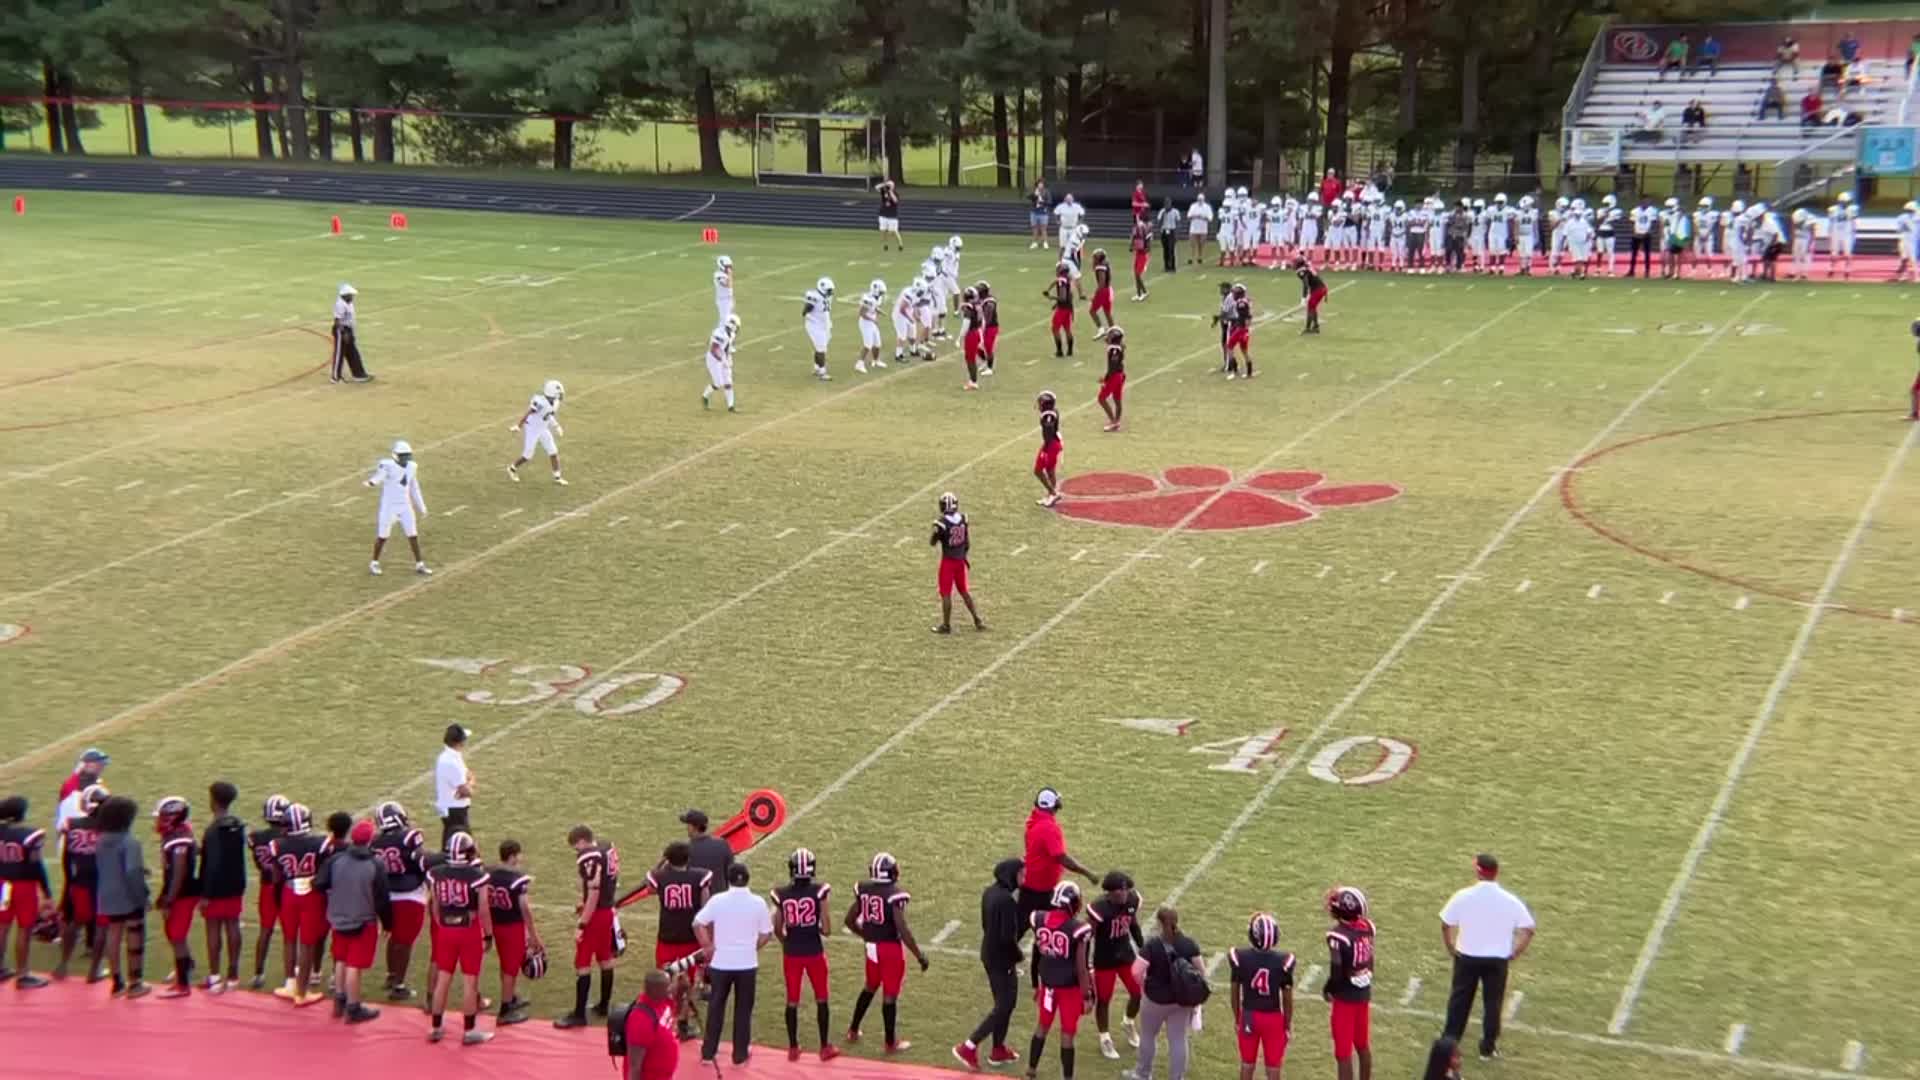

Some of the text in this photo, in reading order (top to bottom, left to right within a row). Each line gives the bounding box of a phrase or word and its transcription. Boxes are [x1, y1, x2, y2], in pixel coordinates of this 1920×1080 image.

[457, 663, 688, 717] 30
[1188, 727, 1418, 785] 40
[664, 883, 693, 909] 61
[861, 894, 885, 925] 13
[783, 897, 817, 927] 82
[1037, 927, 1069, 959] 29
[1251, 968, 1270, 996] 4
